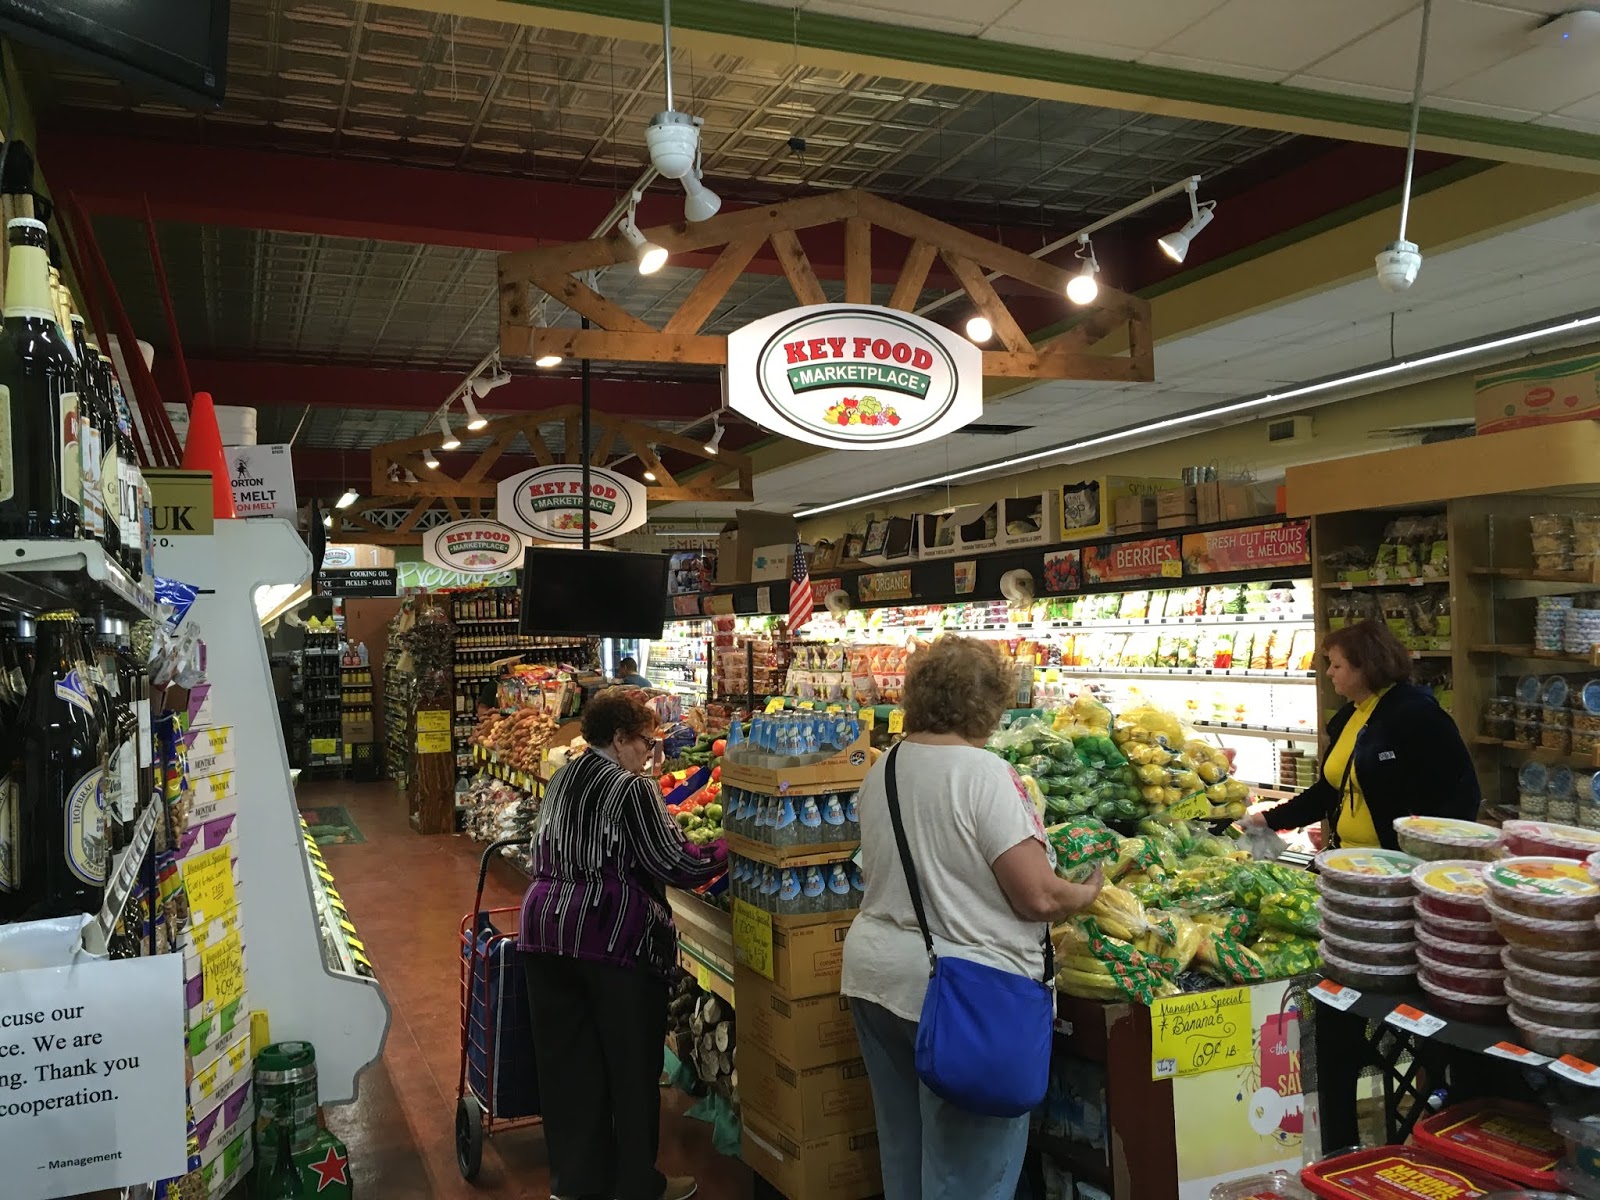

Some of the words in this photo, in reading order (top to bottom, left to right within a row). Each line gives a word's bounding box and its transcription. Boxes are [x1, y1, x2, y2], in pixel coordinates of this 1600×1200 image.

[784, 337, 846, 364] KEY
[853, 337, 933, 370] FOOD
[799, 365, 919, 390] MARKETPLACE
[231, 478, 264, 487] ORTON
[529, 482, 566, 497] KEY
[241, 490, 276, 502] MELT
[538, 497, 609, 510] MARKETPACE
[252, 502, 277, 511] MELT
[152, 506, 195, 530] UK
[446, 532, 472, 543] KEY
[475, 531, 510, 542] FOOD
[1207, 534, 1236, 550] FRESH
[1239, 531, 1260, 546] CUT
[1263, 527, 1302, 543] FRUITS
[452, 542, 505, 551] MARKETPLACE
[1246, 546, 1254, 558] &
[1258, 541, 1302, 557] MELONS
[370, 549, 378, 565] 1
[1117, 545, 1173, 568] BERRIES
[875, 576, 908, 592] ORGANIC
[209, 736, 228, 747] MONTAUK
[194, 757, 216, 769] MONTAUK
[73, 781, 94, 824] HOFBRÄU
[195, 803, 217, 817] MONTAUK
[1160, 999, 1208, 1018] Manager's
[1211, 989, 1244, 1014] Special
[0, 1011, 45, 1028] cuse
[51, 1005, 85, 1021] our
[32, 1034, 67, 1053] We
[73, 1032, 103, 1048] are
[1270, 1041, 1288, 1056] the
[34, 1058, 98, 1082] Thank
[103, 1056, 140, 1077] you
[0, 1088, 119, 1117] cooperation.
[48, 1151, 122, 1171] Management
